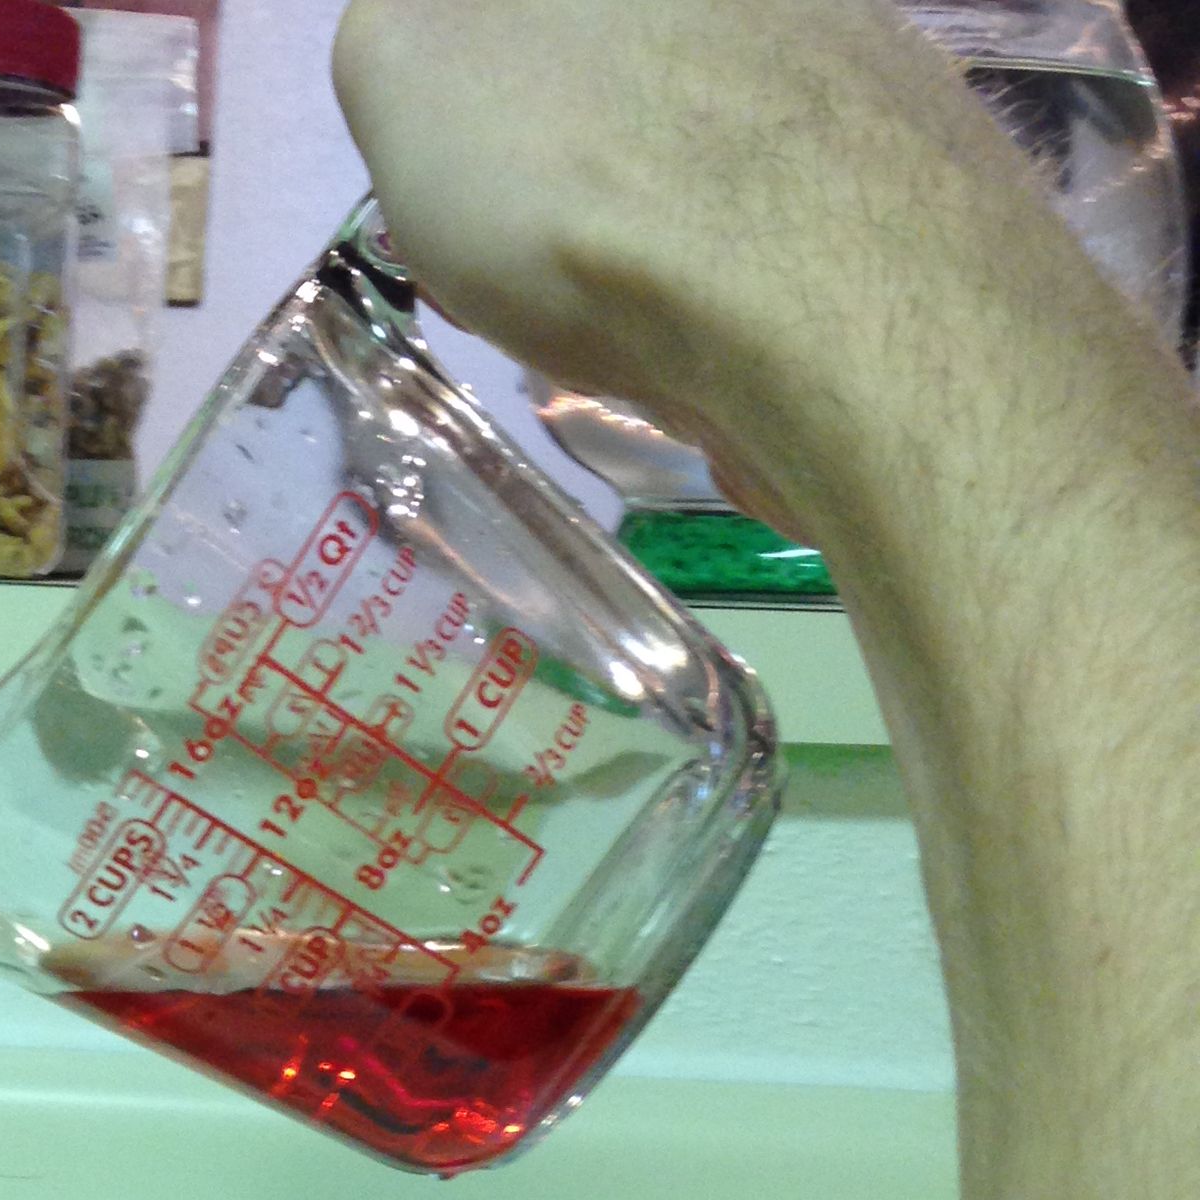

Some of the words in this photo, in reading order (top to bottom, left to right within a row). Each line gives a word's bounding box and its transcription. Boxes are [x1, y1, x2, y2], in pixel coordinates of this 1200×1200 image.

[453, 719, 481, 739] 1
[475, 637, 525, 709] CUP
[69, 910, 100, 931] 2
[86, 828, 154, 908] CUPS
